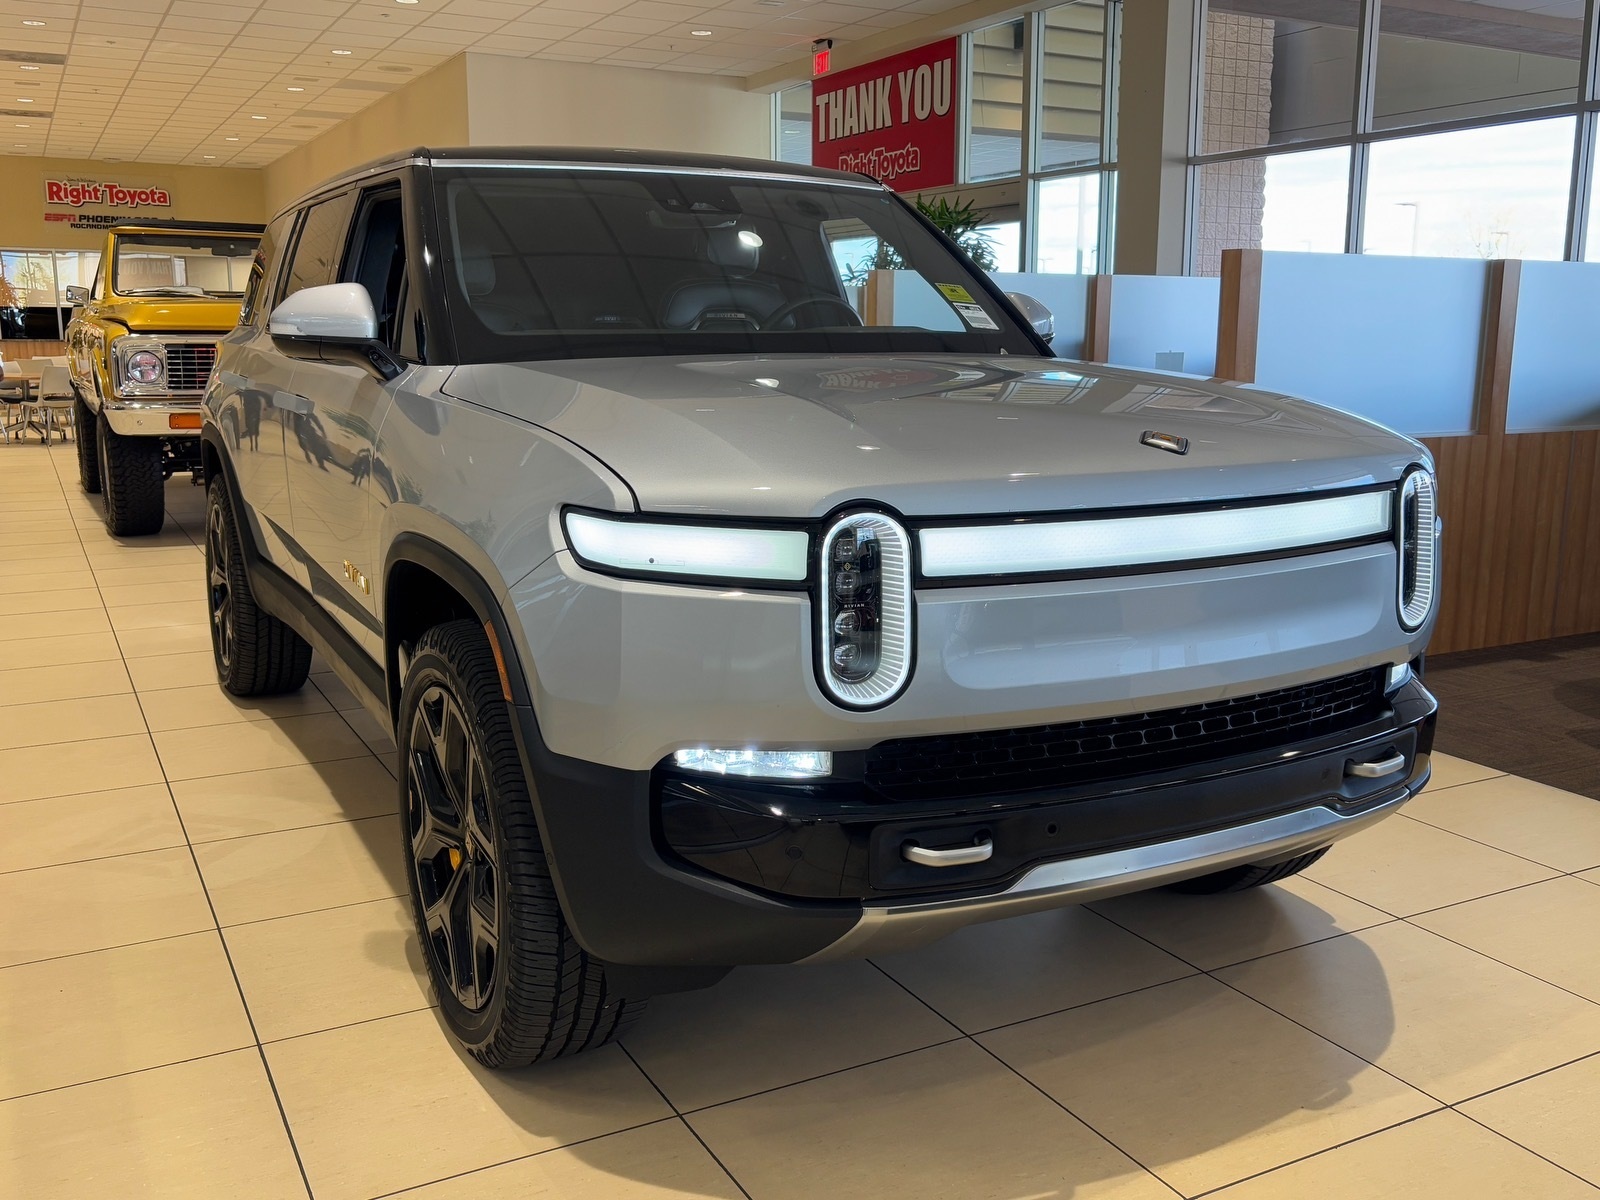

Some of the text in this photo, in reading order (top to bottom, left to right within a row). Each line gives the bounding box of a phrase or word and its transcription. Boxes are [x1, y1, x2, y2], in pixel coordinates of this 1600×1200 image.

[816, 58, 952, 143] THANK YOU
[873, 142, 920, 181] Toyota
[45, 180, 171, 208] Right Toyota
[44, 213, 76, 222] ESPN
